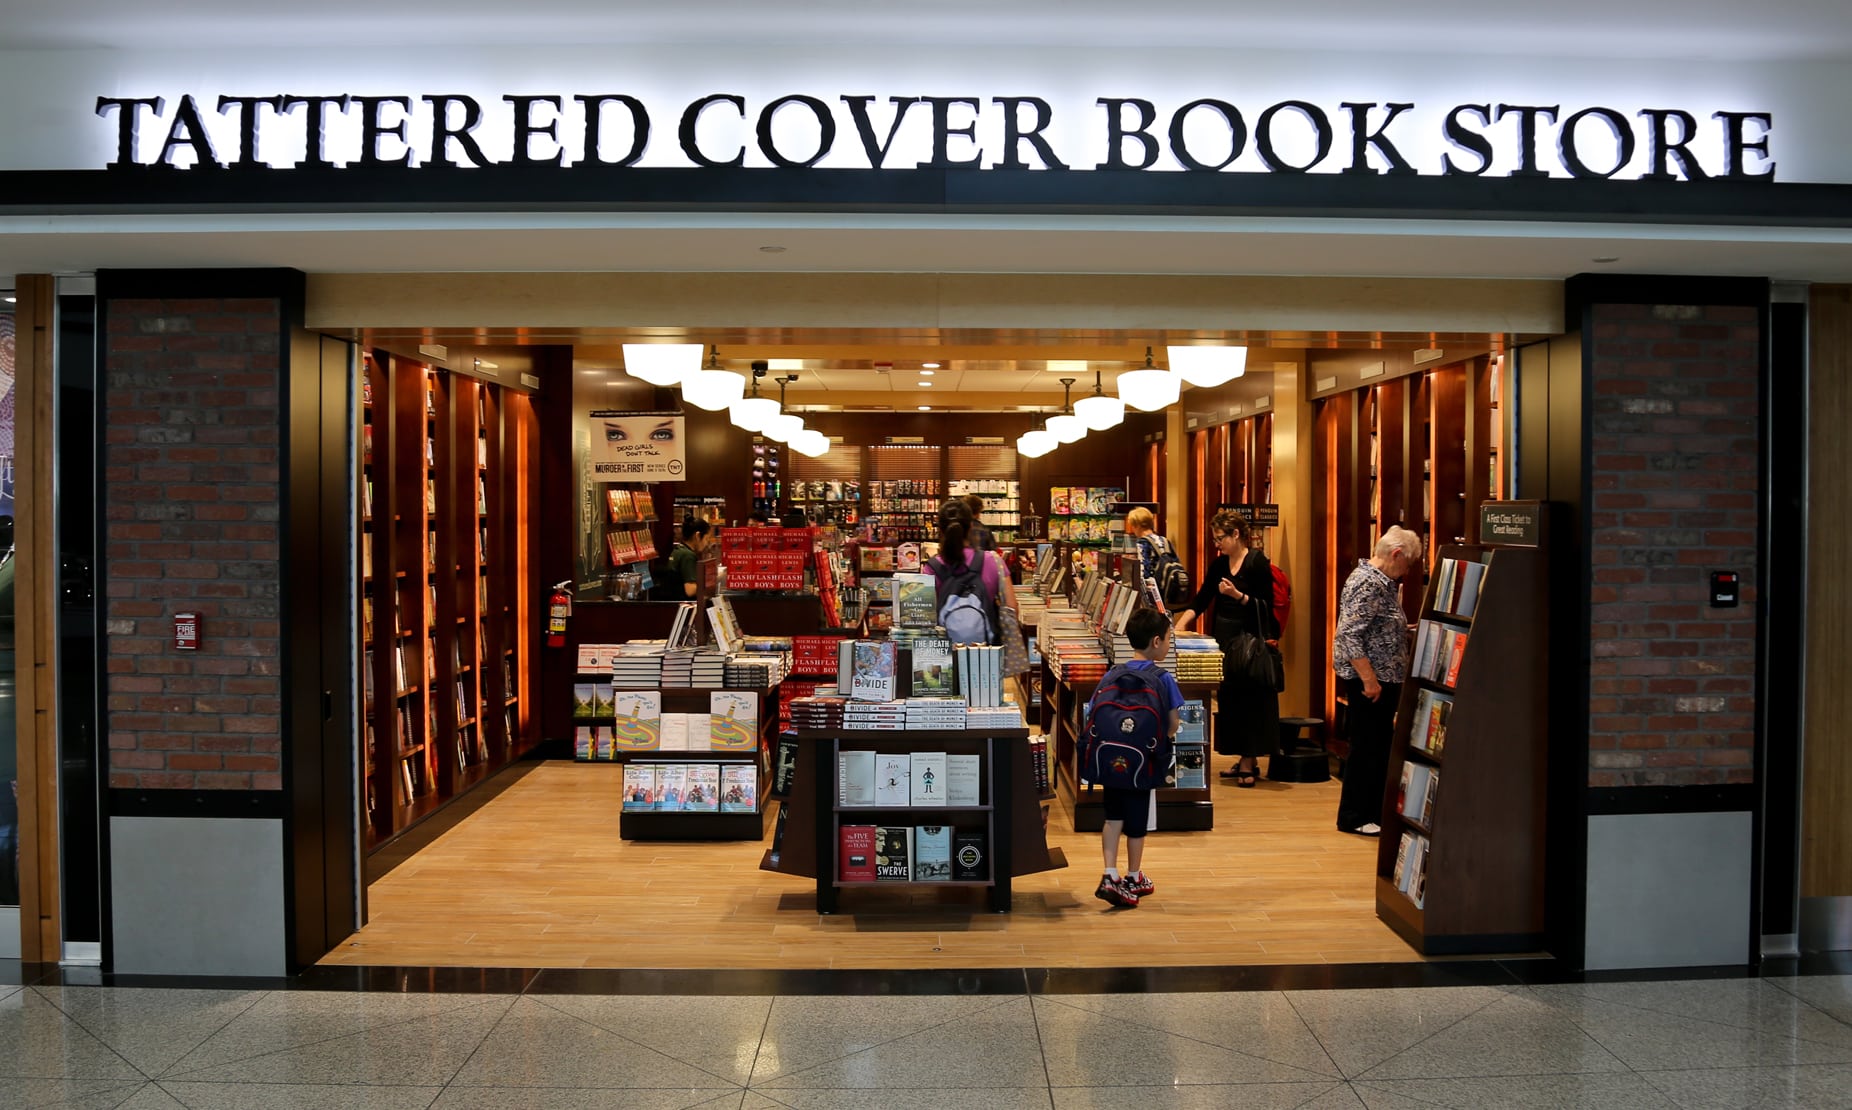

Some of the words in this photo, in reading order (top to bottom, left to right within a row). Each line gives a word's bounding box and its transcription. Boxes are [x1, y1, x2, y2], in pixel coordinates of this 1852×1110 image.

[95, 93, 652, 170] TATTERED
[678, 93, 1070, 170] COVER
[1095, 97, 1418, 175] BOOK
[1441, 103, 1775, 182] STORE
[595, 464, 621, 473] MURDER
[627, 464, 644, 472] FIRST
[1487, 514, 1490, 523] A
[877, 866, 907, 876] SWERVE
